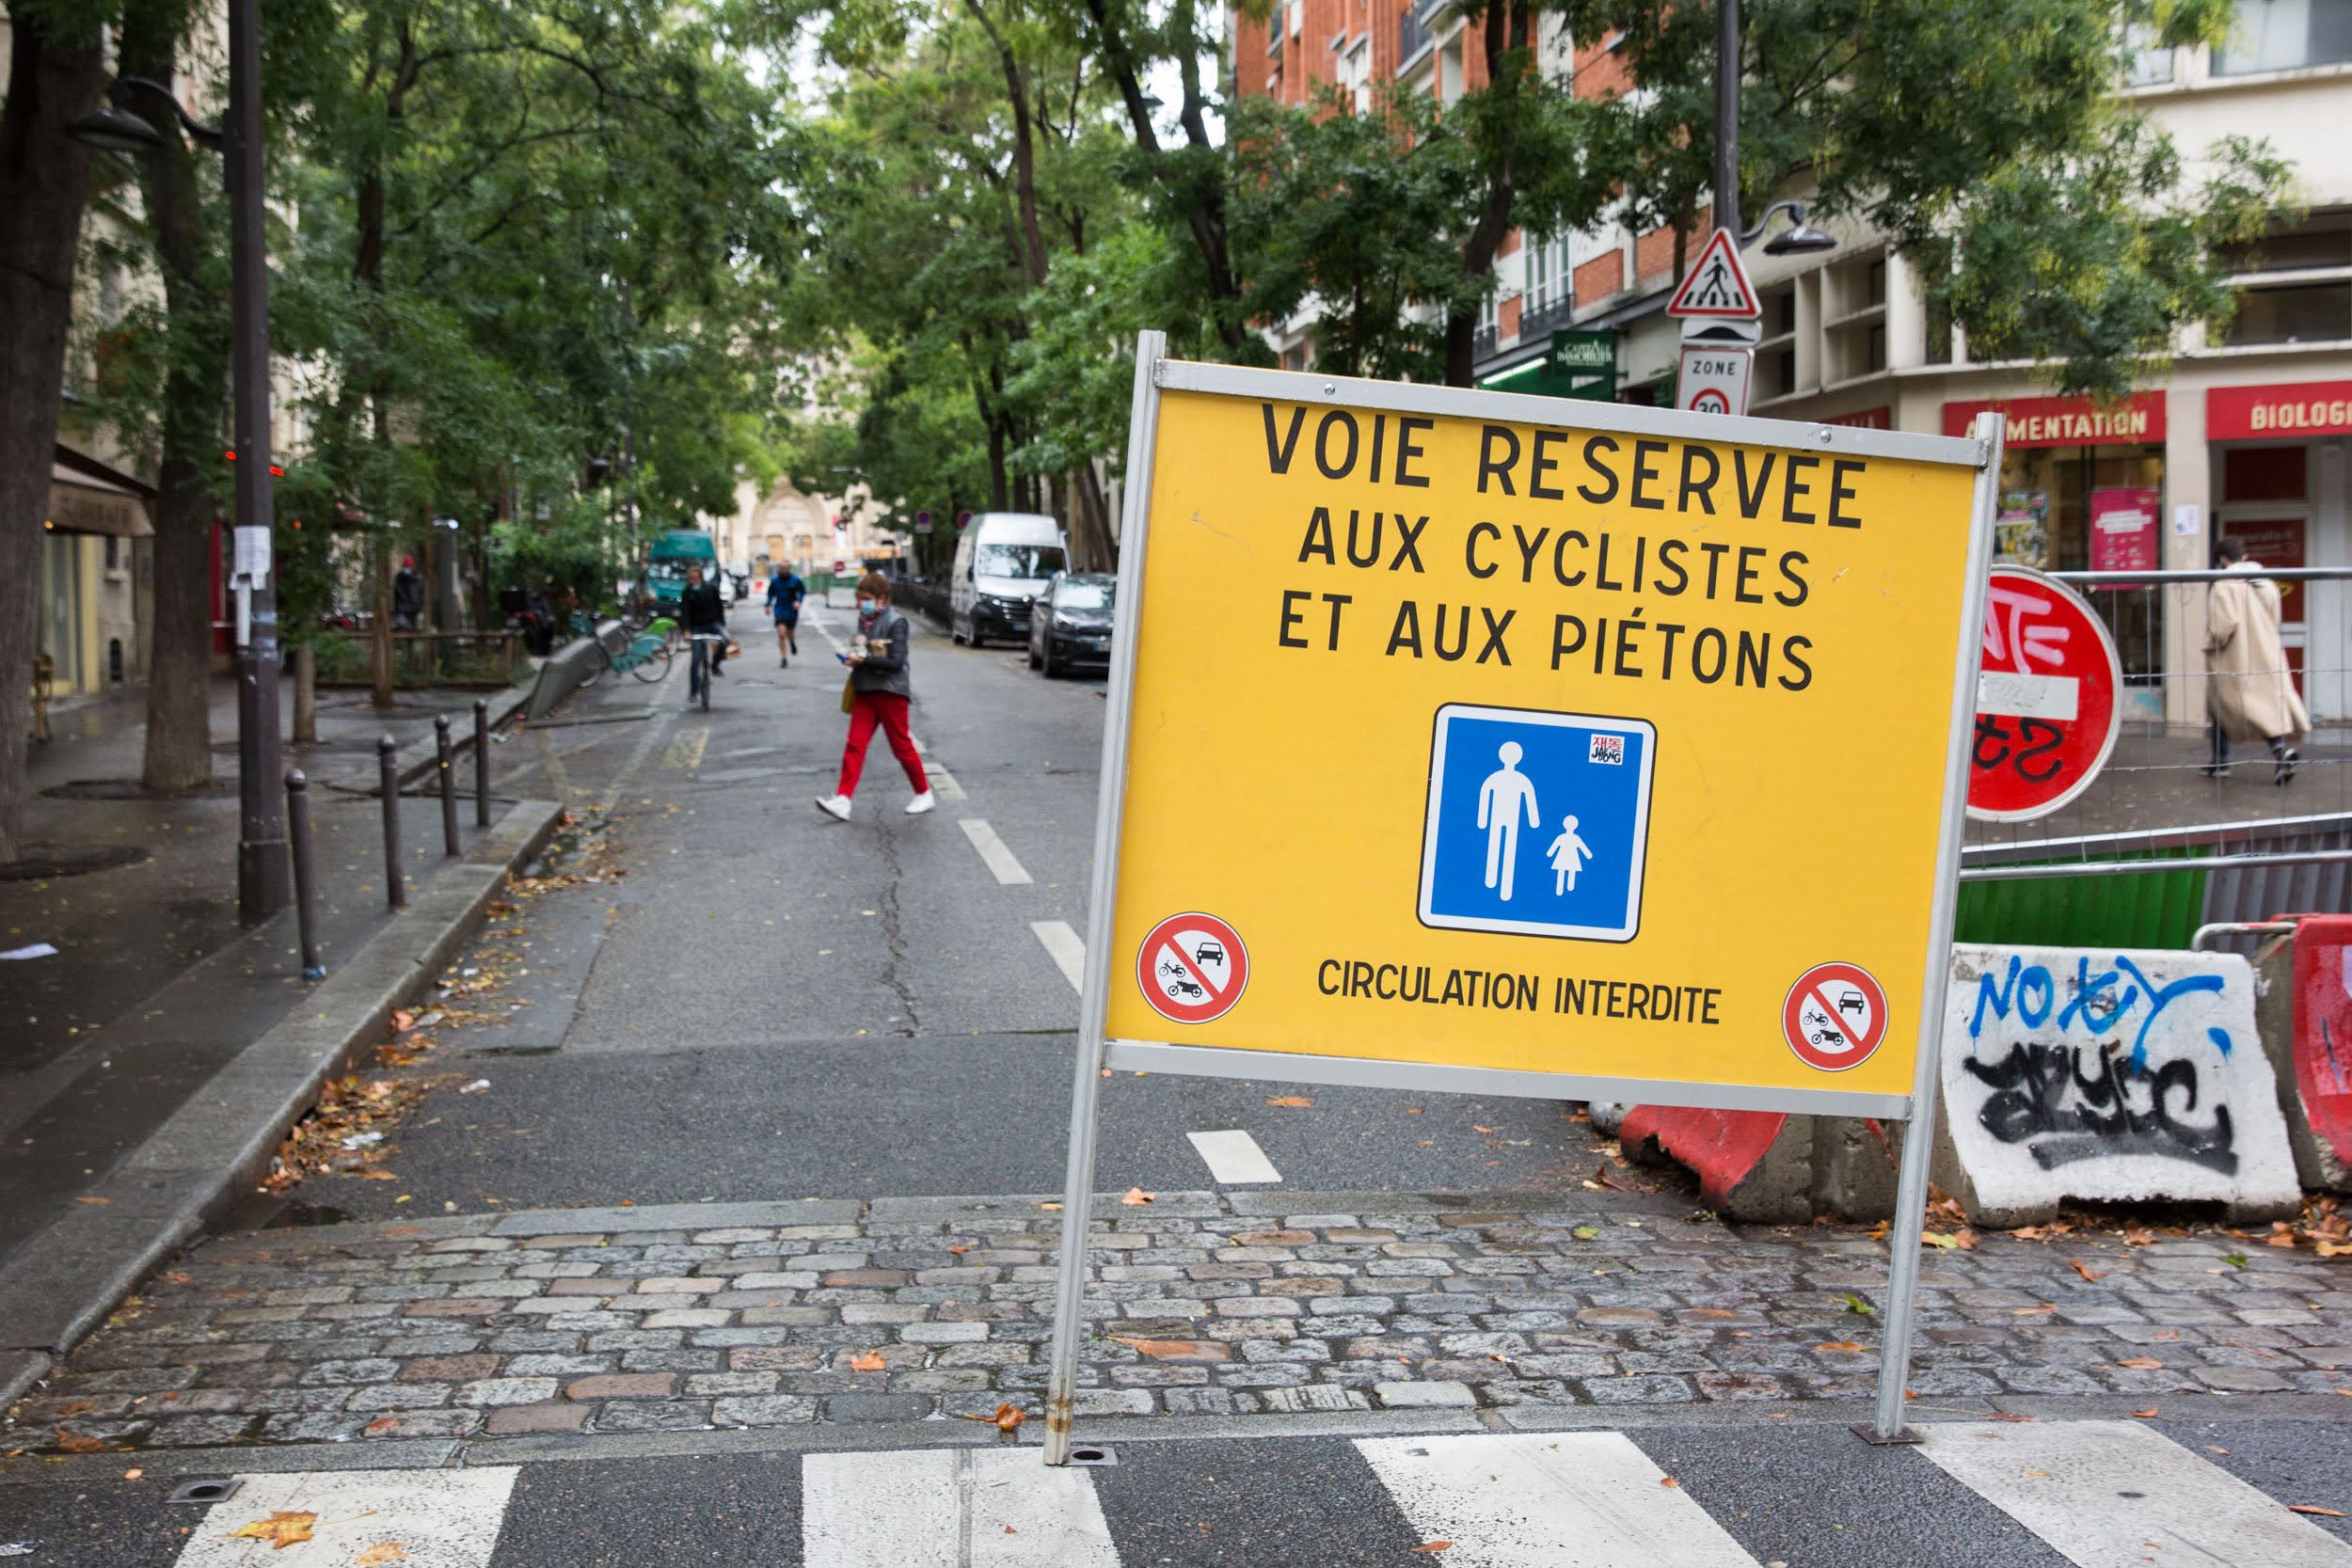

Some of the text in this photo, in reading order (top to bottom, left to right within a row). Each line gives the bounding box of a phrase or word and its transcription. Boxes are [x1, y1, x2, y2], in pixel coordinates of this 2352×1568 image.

[1692, 359, 1737, 376] ZONE
[1262, 404, 1435, 488] VOIE
[1963, 411, 2148, 441] AMENTATION
[1298, 506, 1810, 608] AUX CYCLISTES
[1279, 590, 1813, 691] ET AUX PIÉTONS
[1318, 958, 1722, 1024] CIRCULATION INTERDITE
